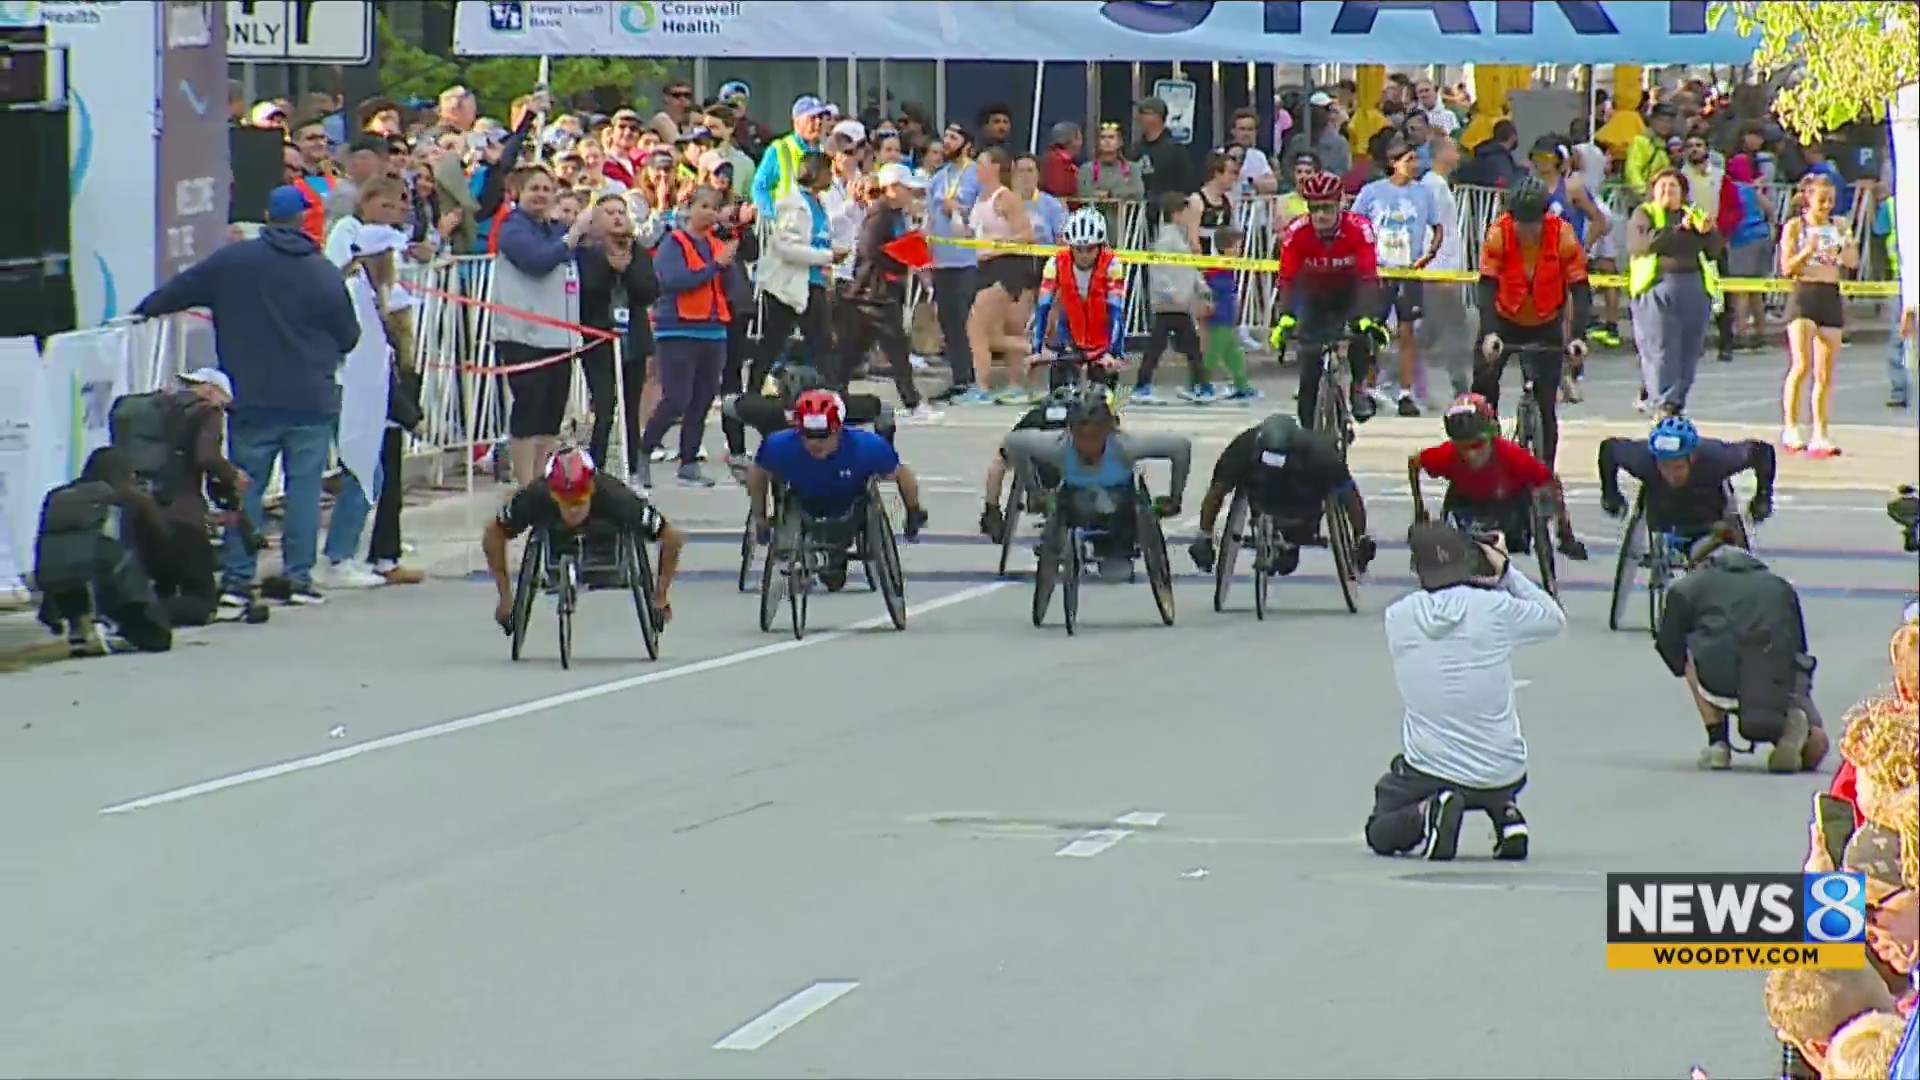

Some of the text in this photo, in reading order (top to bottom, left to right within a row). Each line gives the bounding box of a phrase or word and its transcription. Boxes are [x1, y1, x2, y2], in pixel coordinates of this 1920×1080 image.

[661, 2, 741, 15] Corewell
[226, 23, 281, 45] NLY
[662, 20, 721, 34] Health
